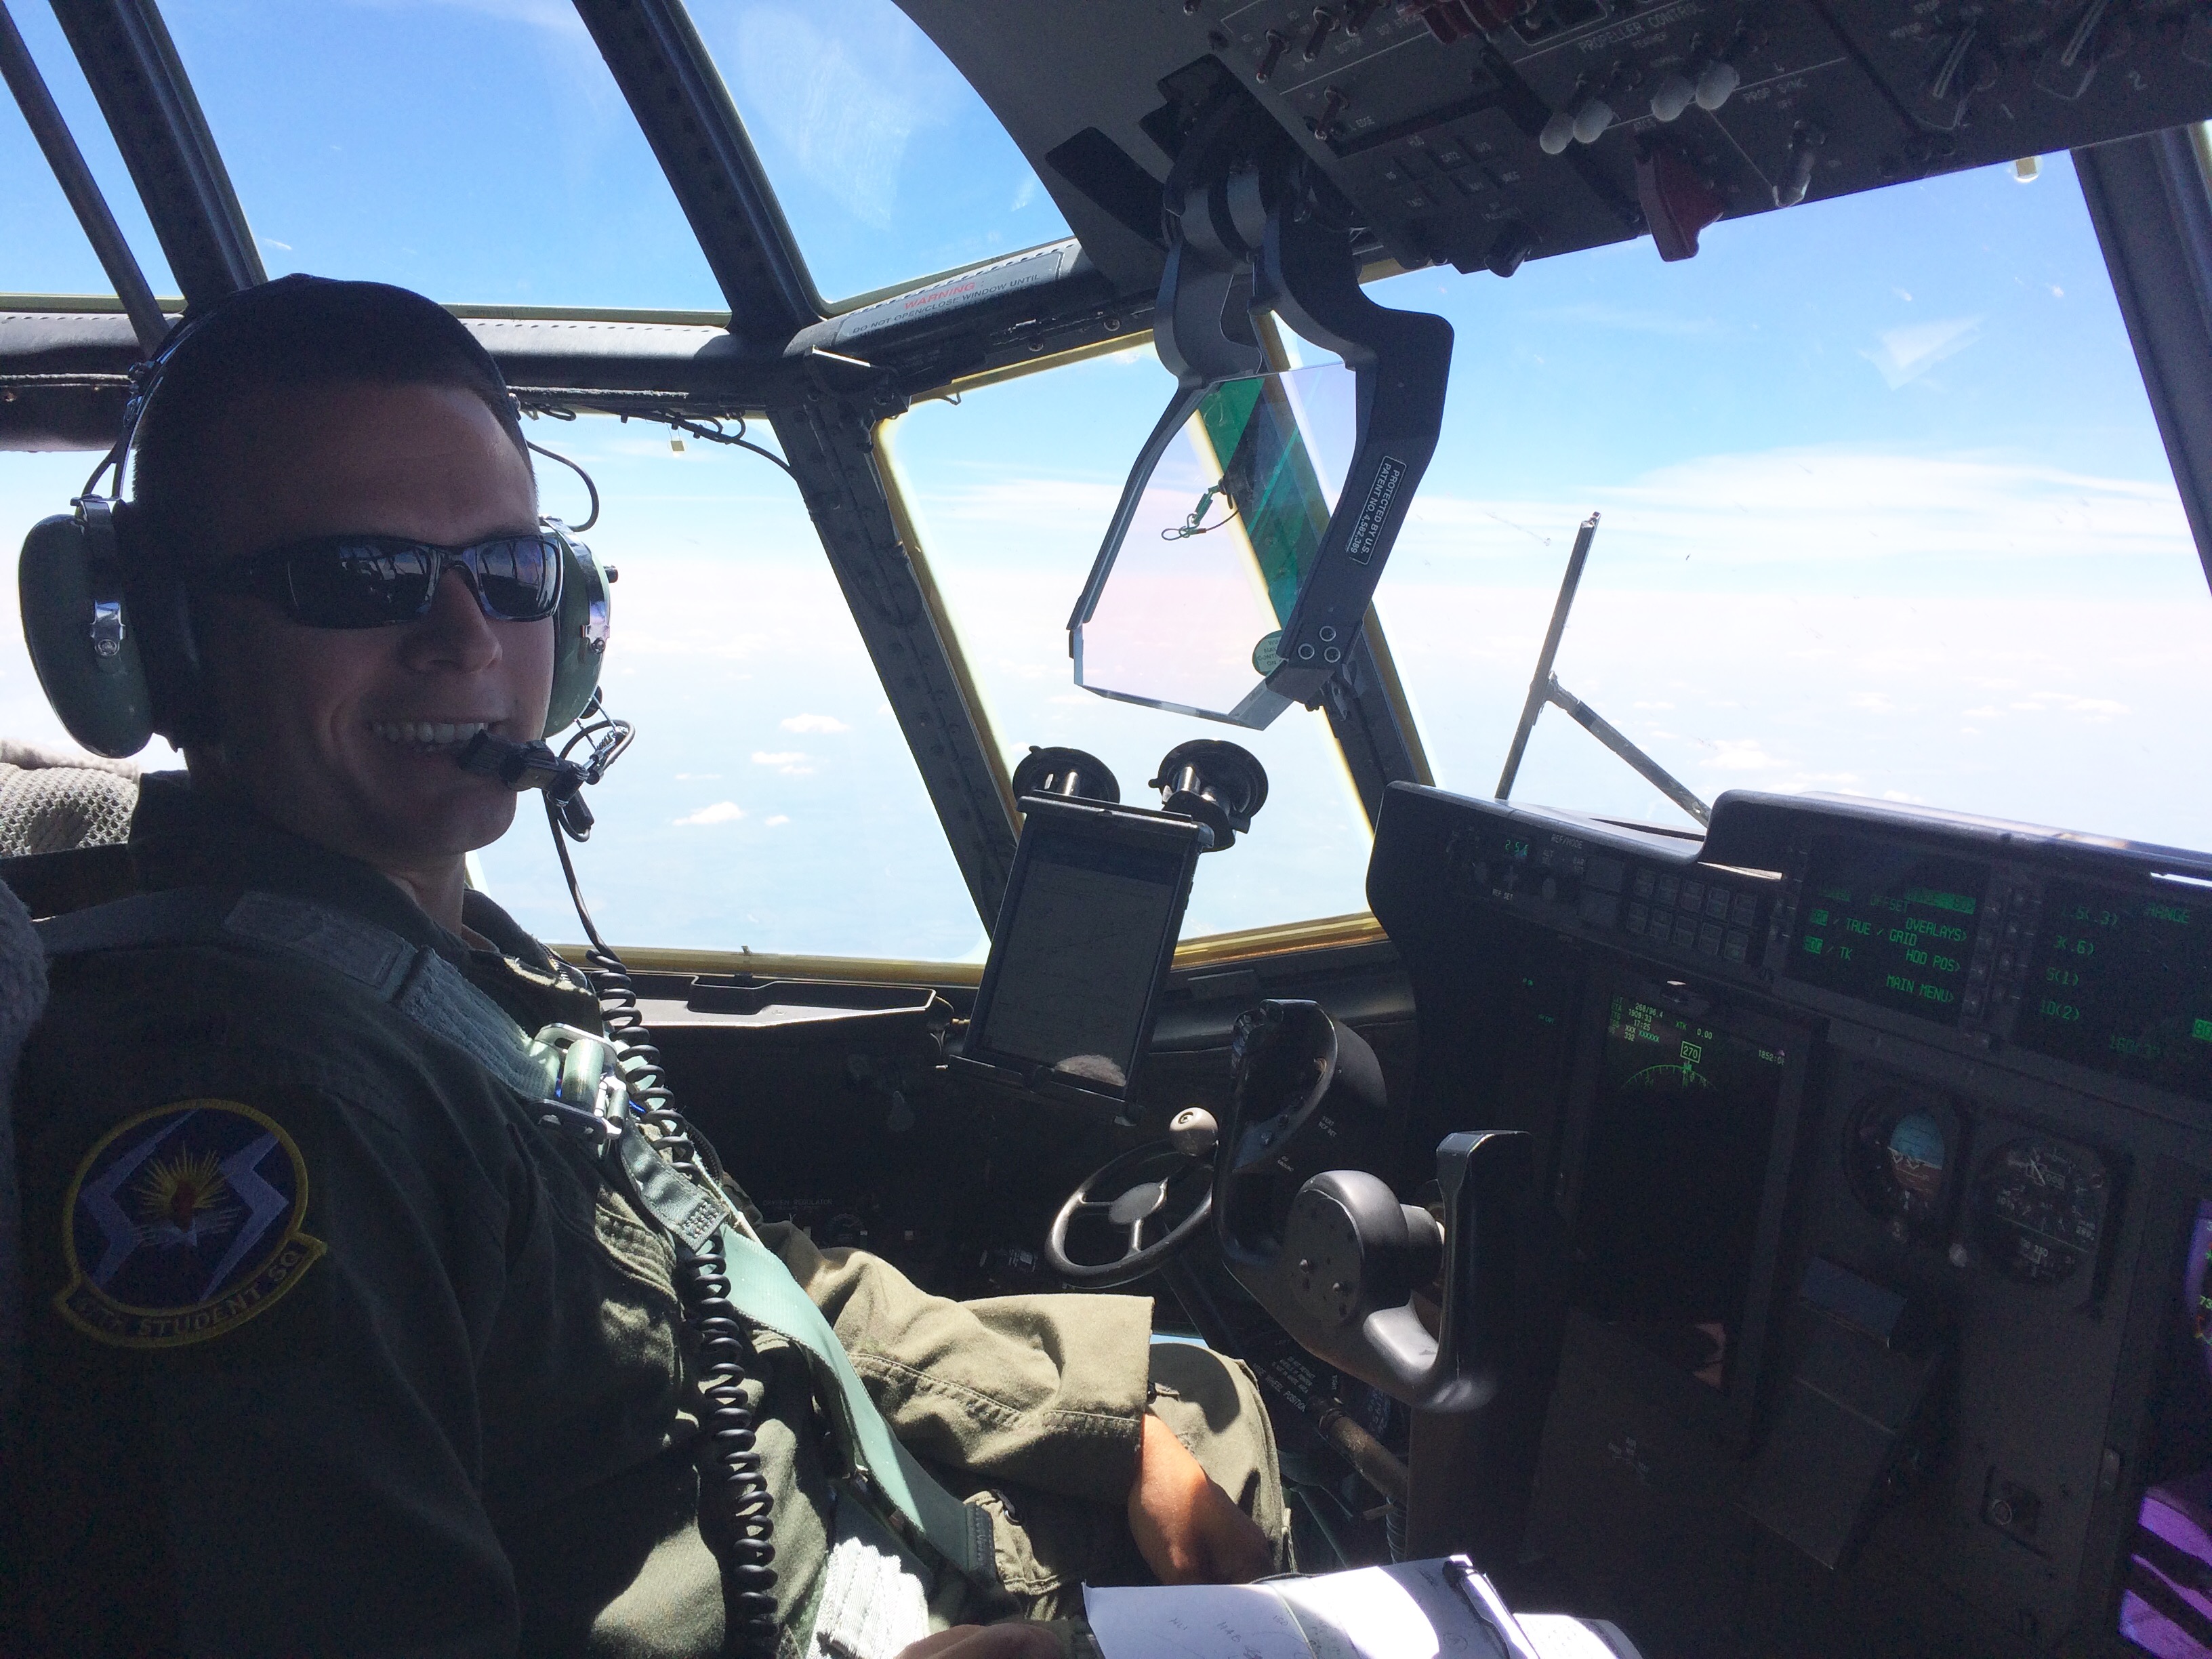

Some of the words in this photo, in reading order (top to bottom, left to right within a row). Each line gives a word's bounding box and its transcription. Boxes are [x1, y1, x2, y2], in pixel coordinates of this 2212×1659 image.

[1578, 21, 1642, 54] PROPELLER
[1647, 2, 1706, 28] CONTROL
[853, 324, 869, 334] DO
[871, 316, 893, 331] NOT
[894, 295, 960, 324] OPEN/CLOSE
[961, 282, 1008, 302] WINDOW
[1009, 274, 1040, 288] UNTIL
[905, 282, 975, 310] WARNING
[1373, 462, 1392, 498] PATENT
[1366, 497, 1378, 512] NO.
[1374, 469, 1401, 525] PROTECTED
[1368, 524, 1378, 538] BY
[1360, 537, 1374, 554] U.S.
[1870, 893, 1910, 914] OFFSET
[1845, 916, 1872, 936] TRUE
[1888, 928, 1918, 947] GRID
[1840, 946, 1853, 961] TK
[1886, 974, 1914, 994] MAIN
[1633, 1019, 1652, 1031] 17:25
[1696, 1027, 1713, 1040] 0.00
[1624, 1032, 1635, 1042] 332
[1683, 1045, 1699, 1060] 270
[137, 1287, 264, 1337] STUDENT
[267, 1248, 300, 1283] SQ
[1265, 1374, 1284, 1393] WHEEL
[1282, 1390, 1307, 1413] POSITION
